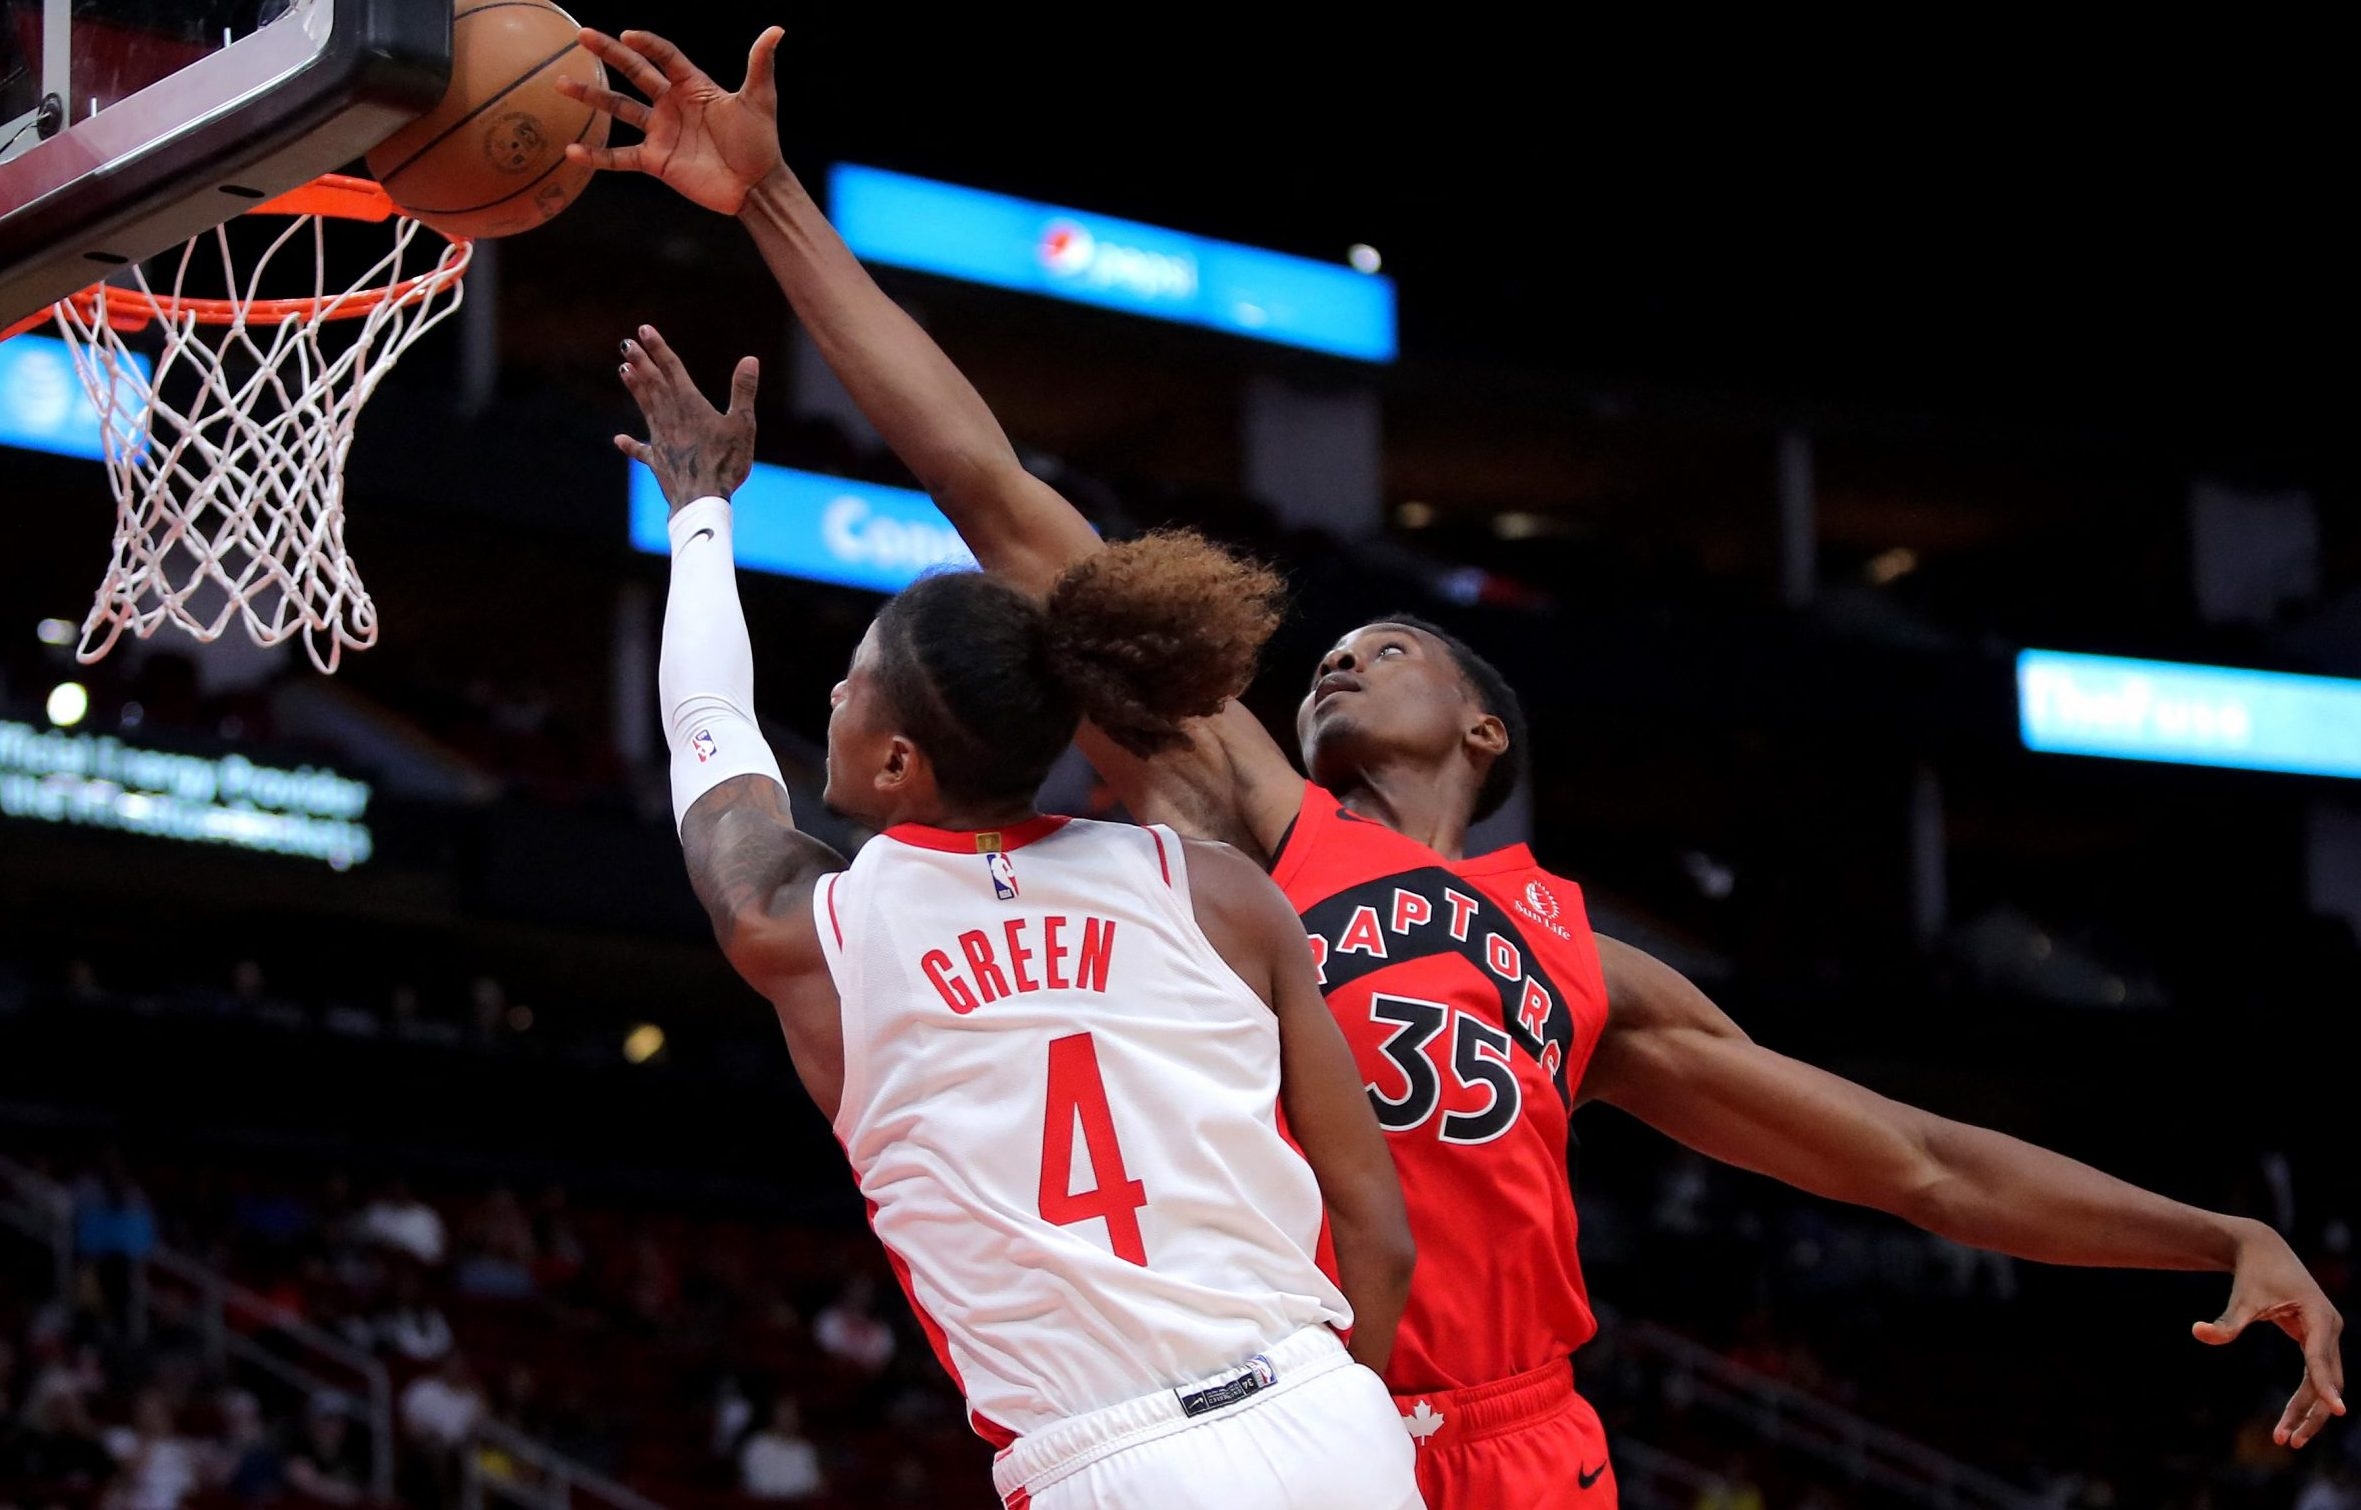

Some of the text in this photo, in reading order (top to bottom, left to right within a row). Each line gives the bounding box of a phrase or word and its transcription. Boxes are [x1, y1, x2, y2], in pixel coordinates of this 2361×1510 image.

[920, 915, 1117, 1015] GREEN
[1515, 899, 1571, 941] Sun Life
[1364, 991, 1523, 1145] 35
[1037, 1031, 1148, 1267] 4
